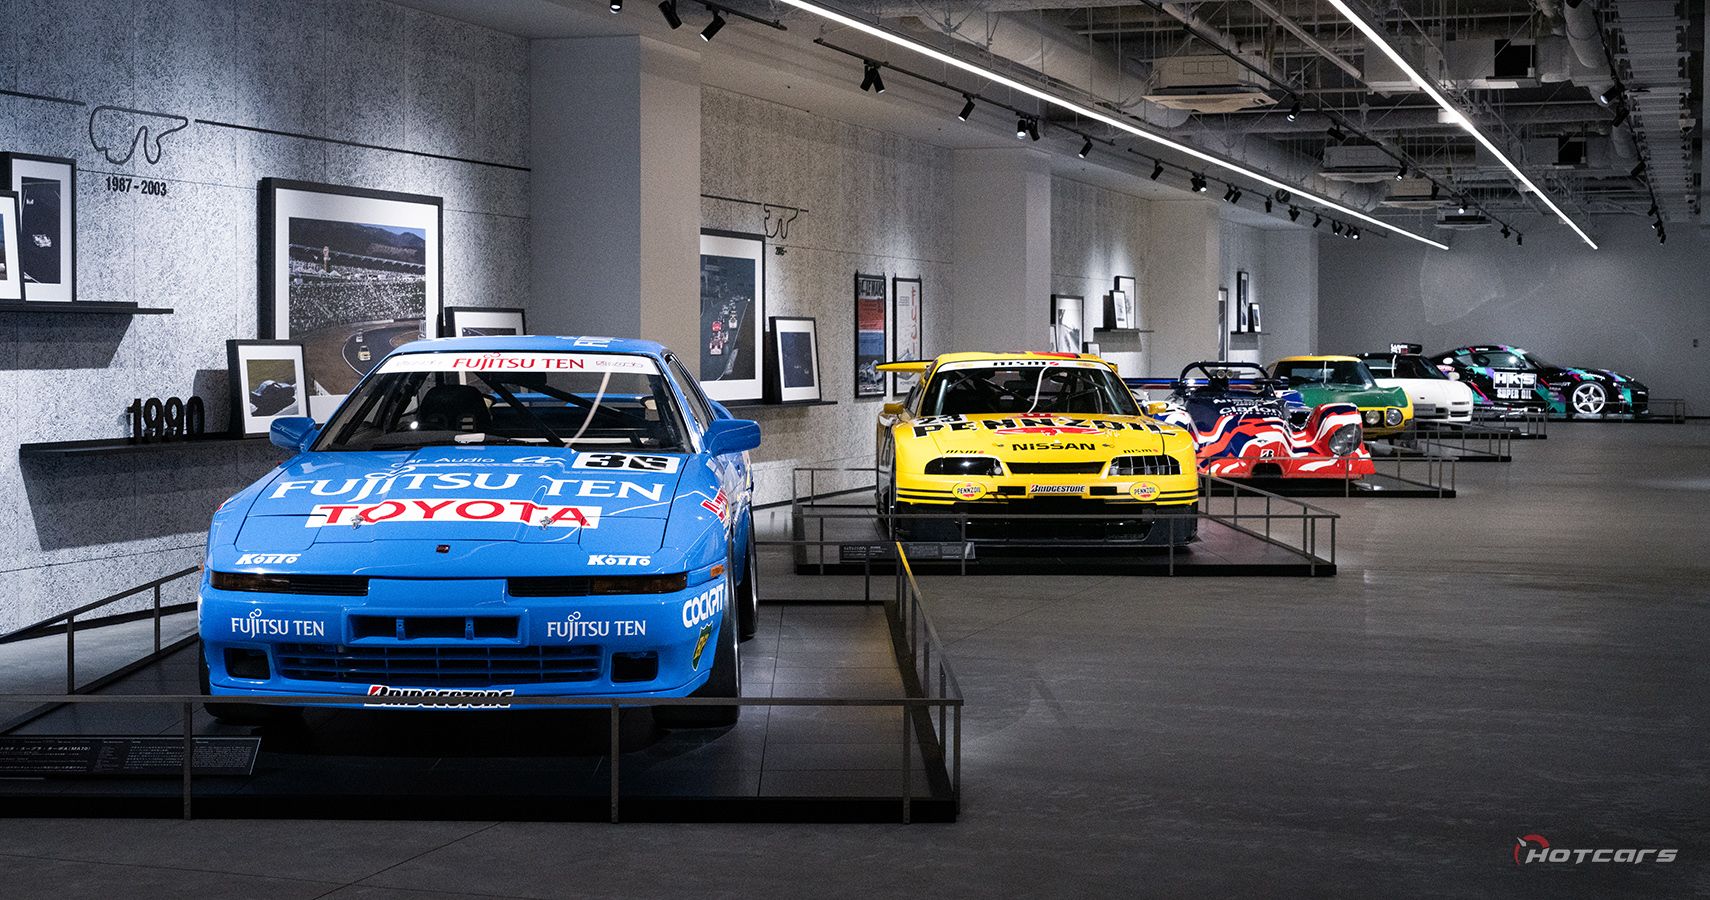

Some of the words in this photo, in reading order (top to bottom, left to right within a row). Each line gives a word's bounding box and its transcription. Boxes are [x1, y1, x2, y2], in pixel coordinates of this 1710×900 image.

[451, 352, 535, 371] FUJITSU
[541, 358, 584, 369] TEN
[1495, 372, 1535, 386] HKS
[127, 396, 205, 441] 1990
[1012, 442, 1095, 451] NISSAN
[268, 466, 522, 502] FUJITSU
[539, 475, 666, 501] TEN
[1030, 484, 1086, 493] BRIDGESTONE
[319, 500, 591, 527] TOYOTA
[682, 582, 724, 629] COCKPIT
[231, 609, 289, 639] FUJITSU
[293, 620, 324, 636] TEN
[547, 611, 609, 642] FUJITSU
[614, 620, 646, 636] TEN
